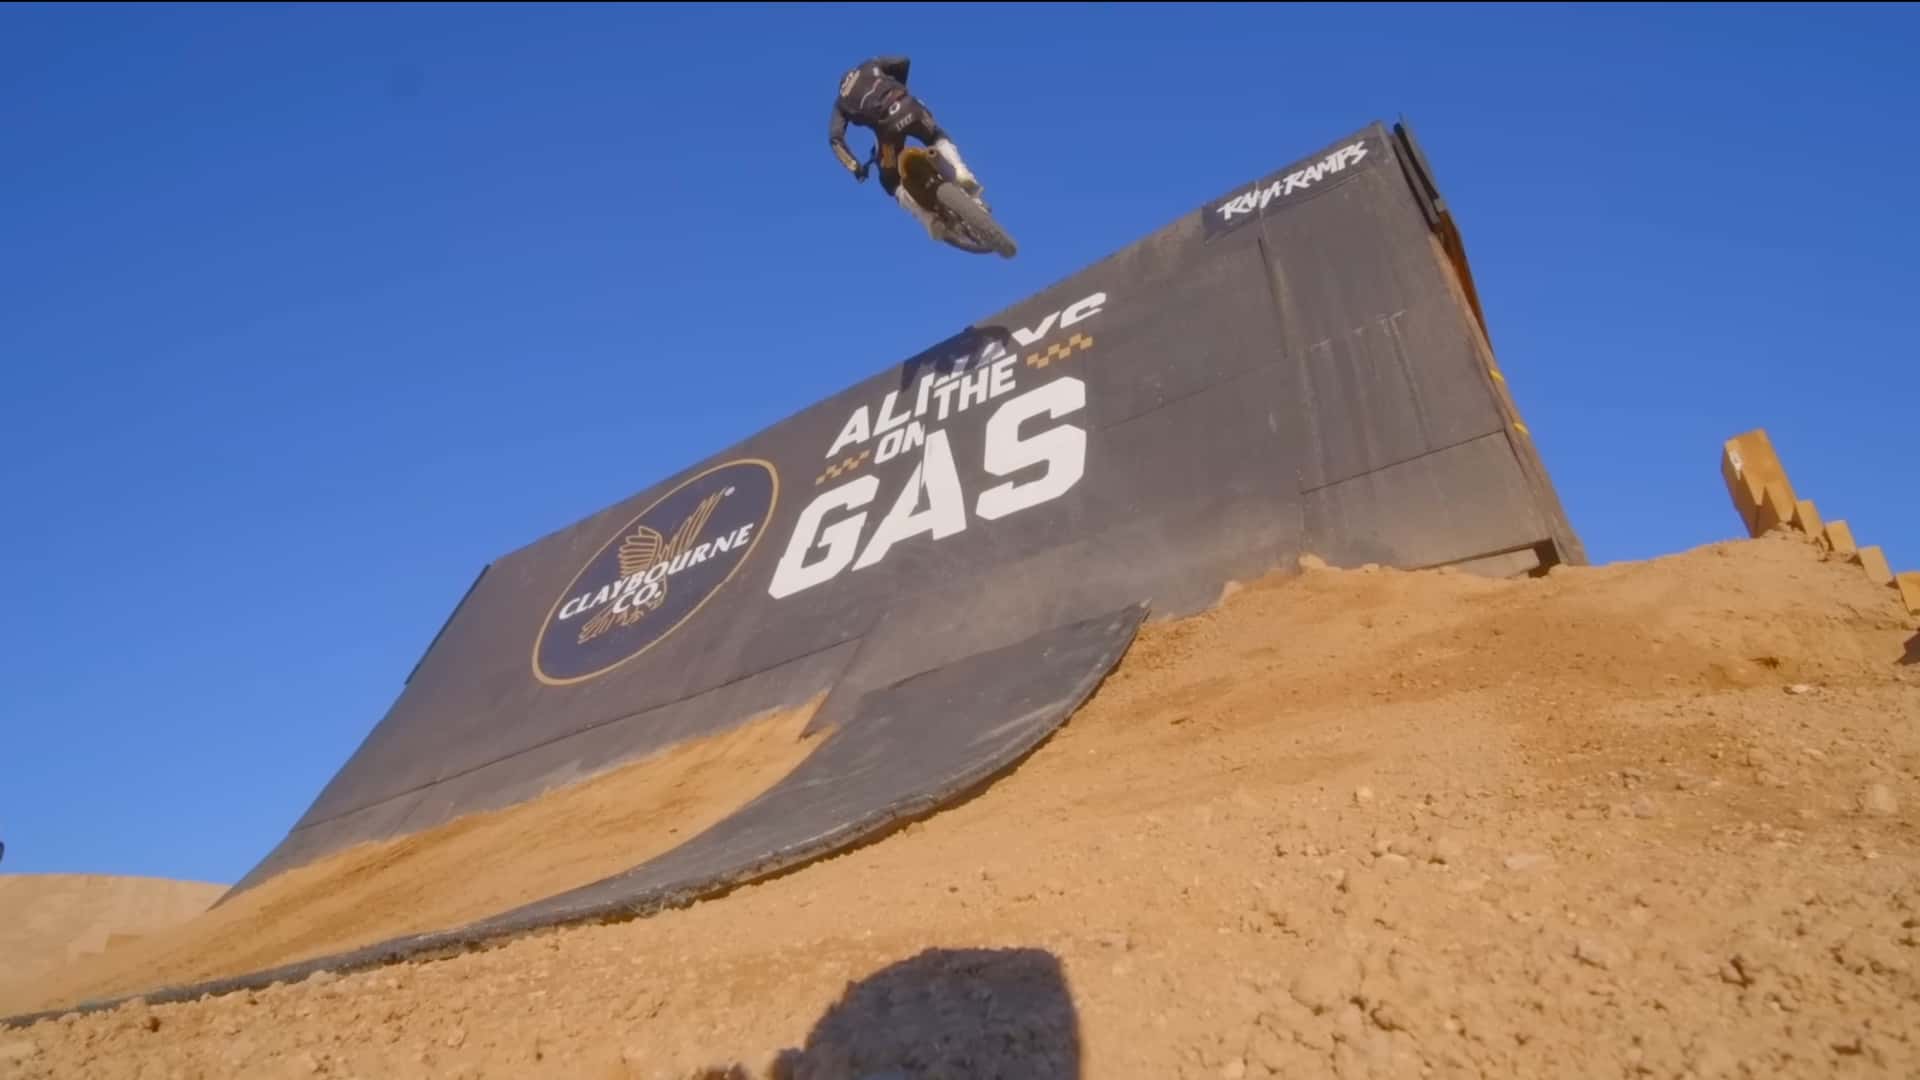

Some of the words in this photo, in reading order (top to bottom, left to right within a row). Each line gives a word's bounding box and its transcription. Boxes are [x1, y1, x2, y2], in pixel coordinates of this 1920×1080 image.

[1282, 140, 1368, 196] RAMPS
[874, 420, 926, 465] ON
[934, 353, 1017, 421] THE
[768, 376, 1087, 600] GAS
[558, 523, 754, 620] CLAYBOURNE
[612, 581, 662, 615] CO.
